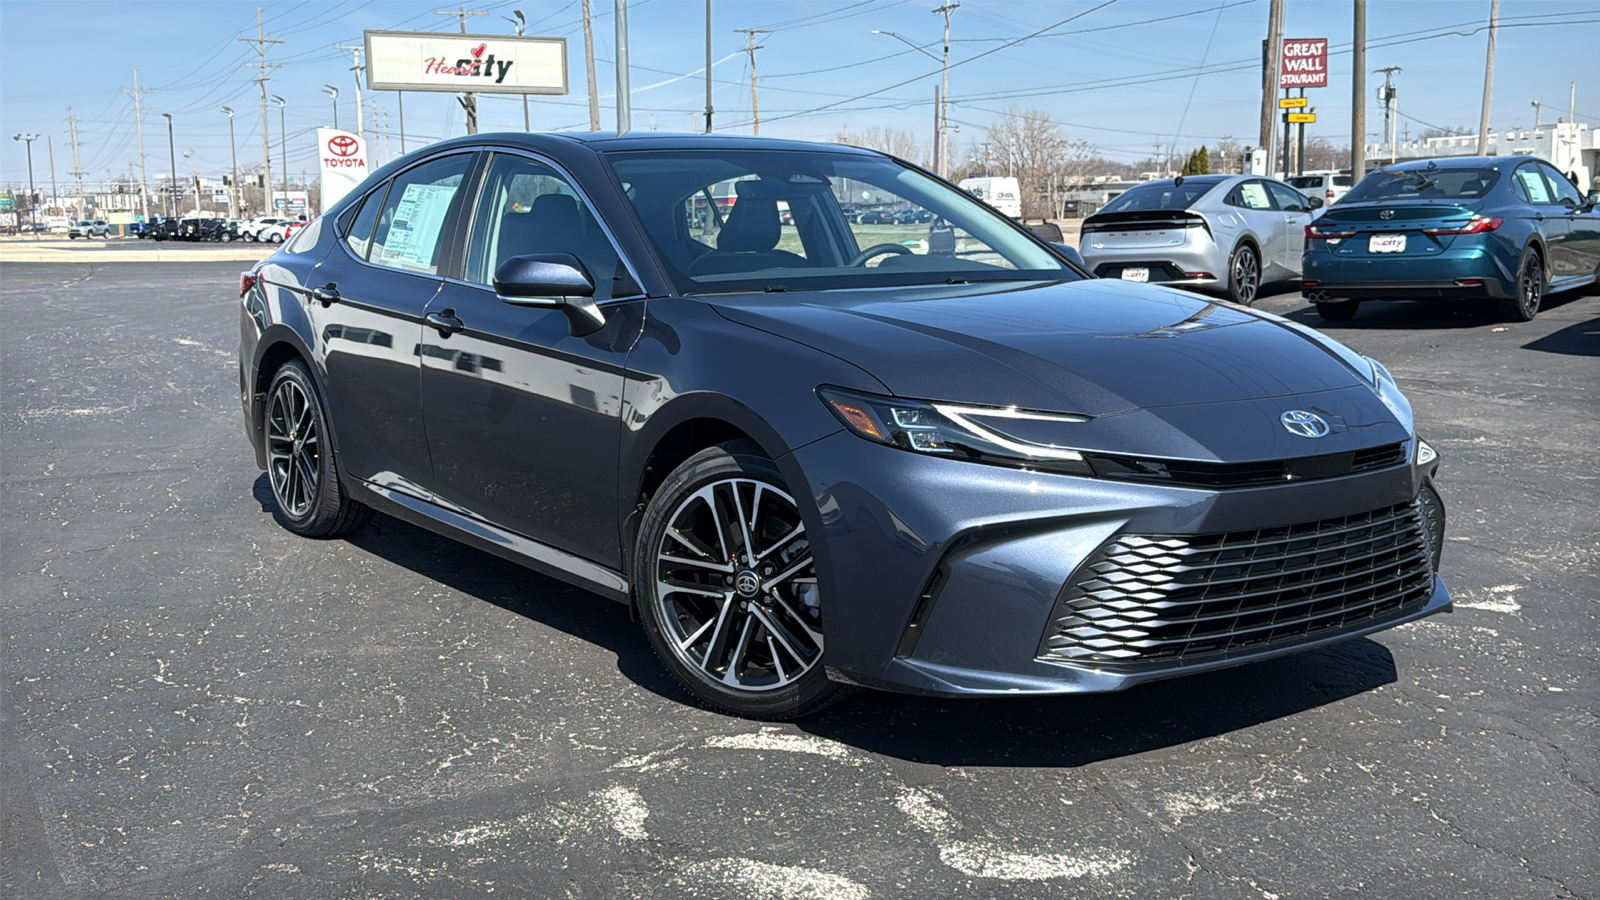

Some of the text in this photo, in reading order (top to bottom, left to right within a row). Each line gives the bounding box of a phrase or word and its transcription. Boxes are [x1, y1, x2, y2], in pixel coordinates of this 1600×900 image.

[1284, 43, 1325, 56] GREAT
[424, 43, 513, 83] Heart city
[1285, 58, 1322, 71] WALL
[1281, 73, 1325, 84] STAURANT
[323, 158, 365, 167] TOYOTA
